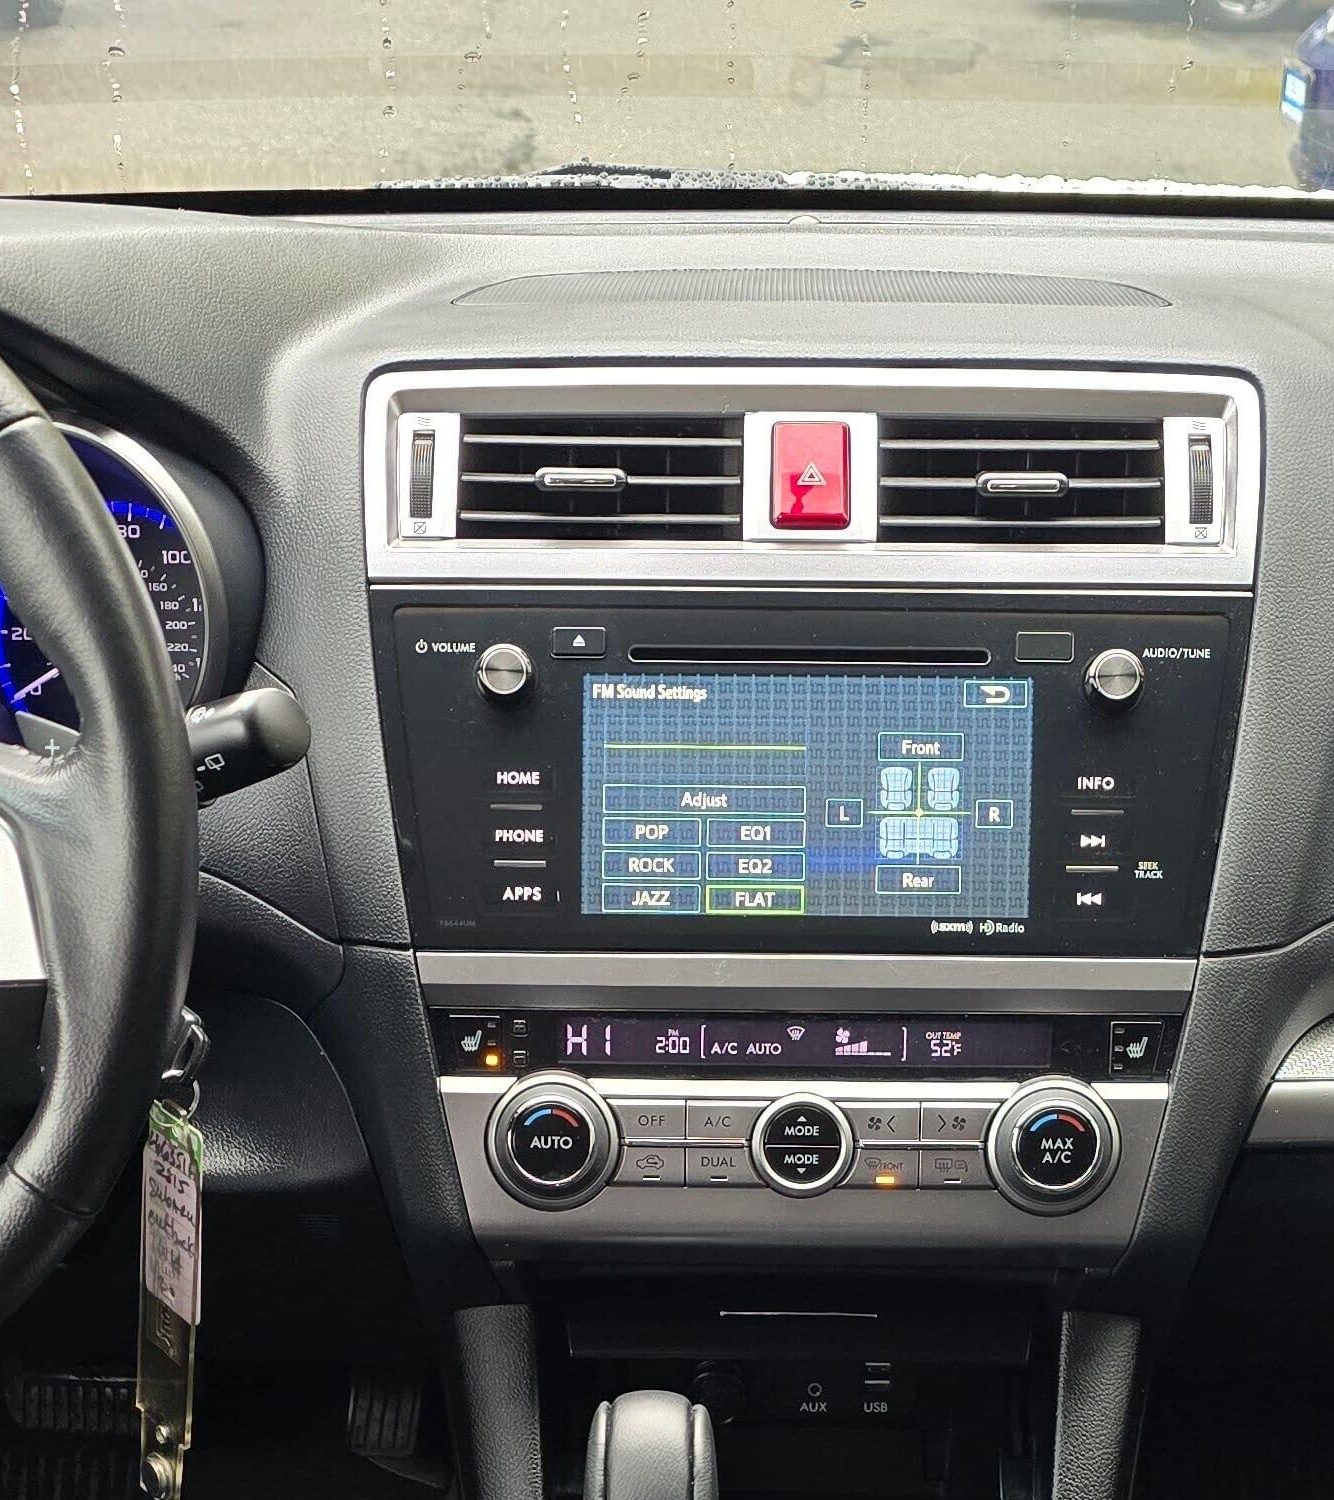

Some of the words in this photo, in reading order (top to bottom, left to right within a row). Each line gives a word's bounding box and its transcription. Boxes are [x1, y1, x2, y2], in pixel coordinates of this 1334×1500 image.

[165, 620, 188, 630] 200
[431, 642, 476, 653] VOLUME
[1142, 648, 1211, 660] AUDIO/TUNE
[592, 684, 614, 699] FM
[616, 684, 655, 700] Sound
[657, 684, 708, 702] Settings
[901, 740, 941, 756] Front
[496, 771, 540, 785] HOME
[1077, 776, 1115, 791] INFO
[680, 791, 728, 810] Adjust
[839, 805, 850, 822] L
[988, 807, 1001, 824] R
[495, 829, 544, 843] PHONE
[634, 824, 669, 840] POP
[740, 826, 772, 842] EQ1
[628, 856, 675, 874] ROCK
[738, 858, 773, 875] EQ2
[1138, 861, 1159, 870] SEEK
[902, 872, 935, 889] Rear
[1134, 870, 1164, 879] TRACK
[502, 886, 542, 901] APPS
[631, 890, 671, 906] JAZZ
[734, 892, 776, 907] FLAT
[995, 923, 1025, 934] Radio
[668, 1028, 680, 1037] PM
[925, 1031, 944, 1040] OUT
[944, 1031, 962, 1040] TEMP
[655, 1036, 690, 1054] 2:00
[710, 1042, 738, 1055] A/C
[746, 1043, 782, 1056] AUTO
[637, 1114, 666, 1127] OFF
[703, 1115, 732, 1128] A/C
[783, 1124, 820, 1137] MODE
[529, 1136, 573, 1150] AUTO
[1040, 1137, 1074, 1151] MAX
[700, 1157, 737, 1169] DUAL
[783, 1153, 820, 1165] MODE
[1041, 1151, 1072, 1164] A/C
[879, 1161, 904, 1171] FRONT
[798, 1402, 828, 1414] AUX
[863, 1402, 889, 1413] USB
